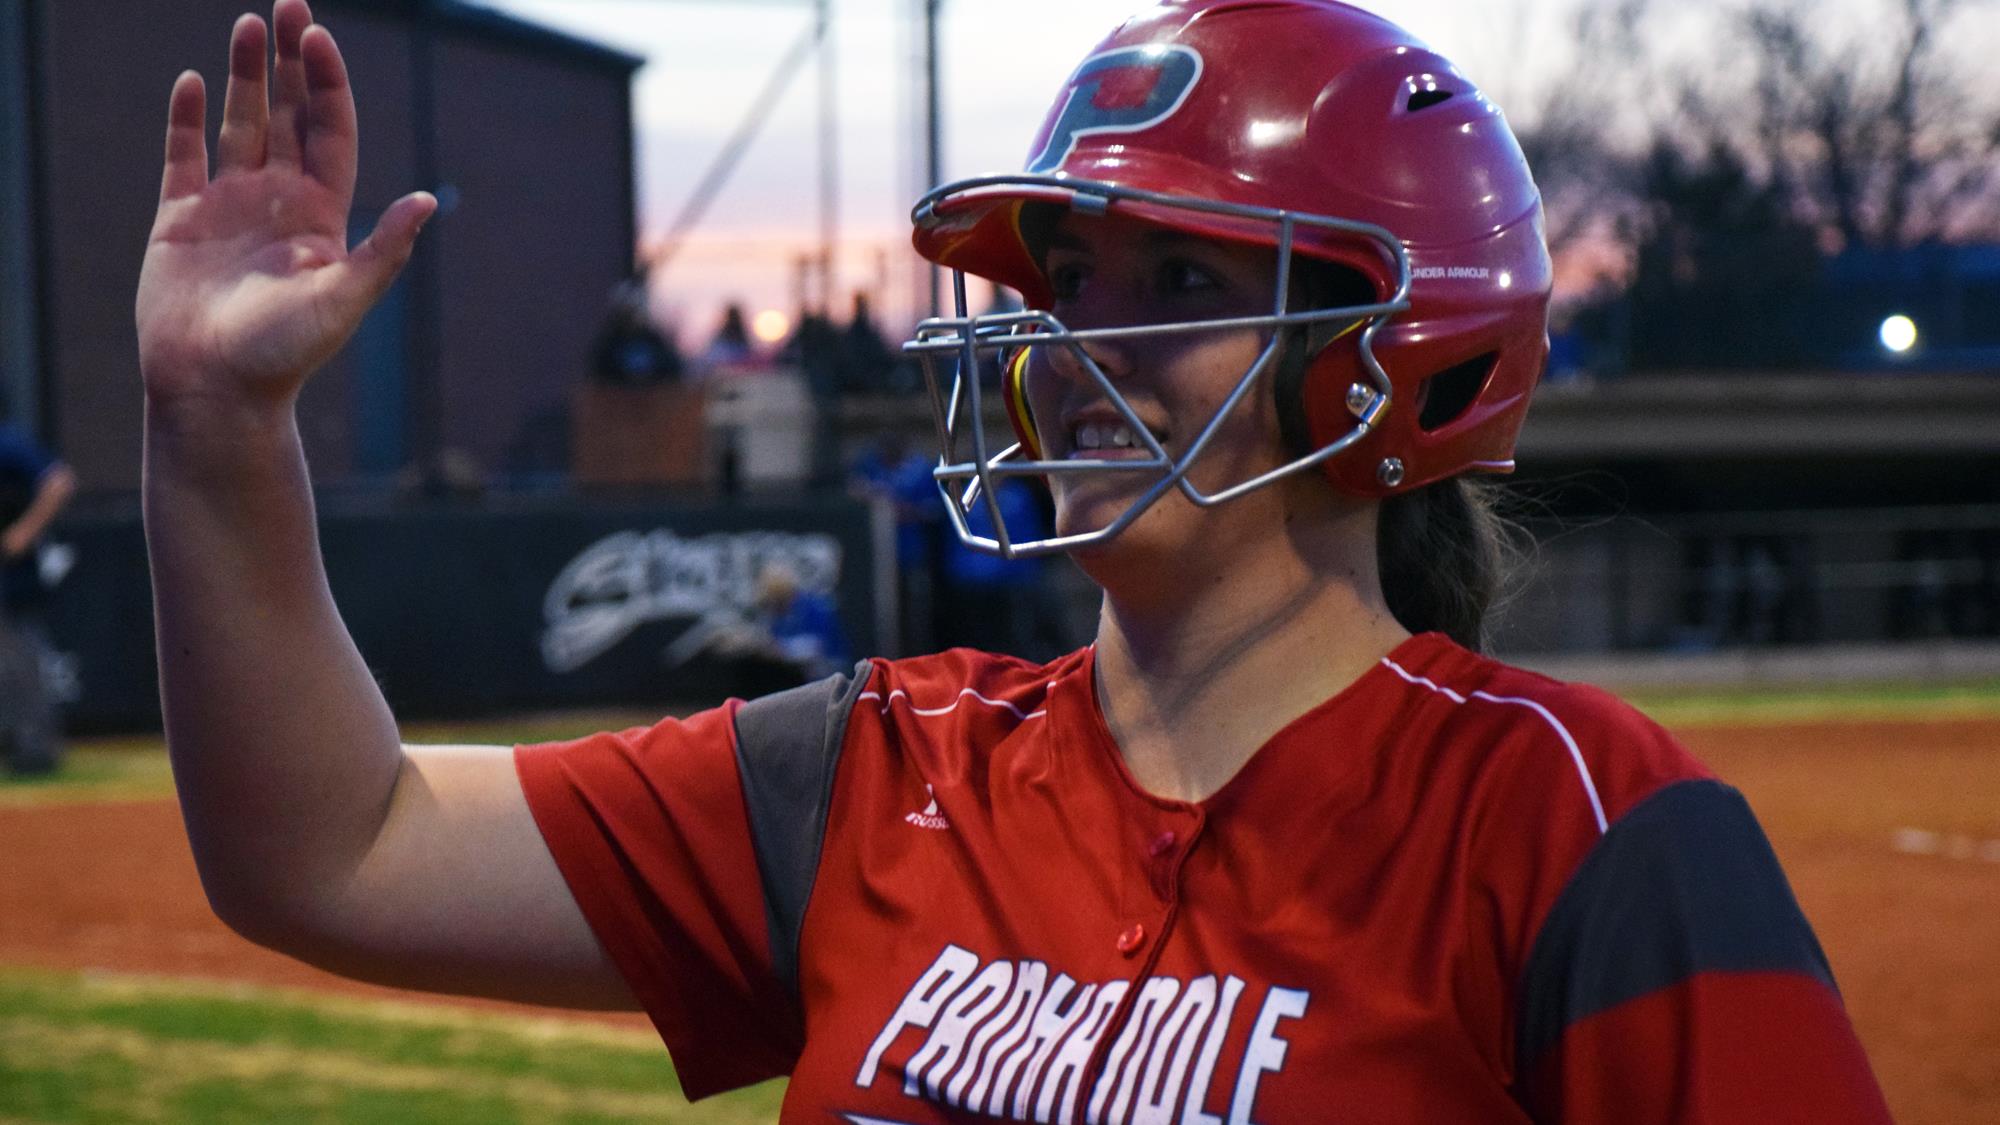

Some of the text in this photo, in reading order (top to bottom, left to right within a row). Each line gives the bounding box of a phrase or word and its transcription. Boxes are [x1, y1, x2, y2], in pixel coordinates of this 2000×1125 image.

[1027, 43, 1204, 175] P
[1447, 267, 1489, 278] ARMOUR
[855, 943, 1310, 1125] PANHANDLE
